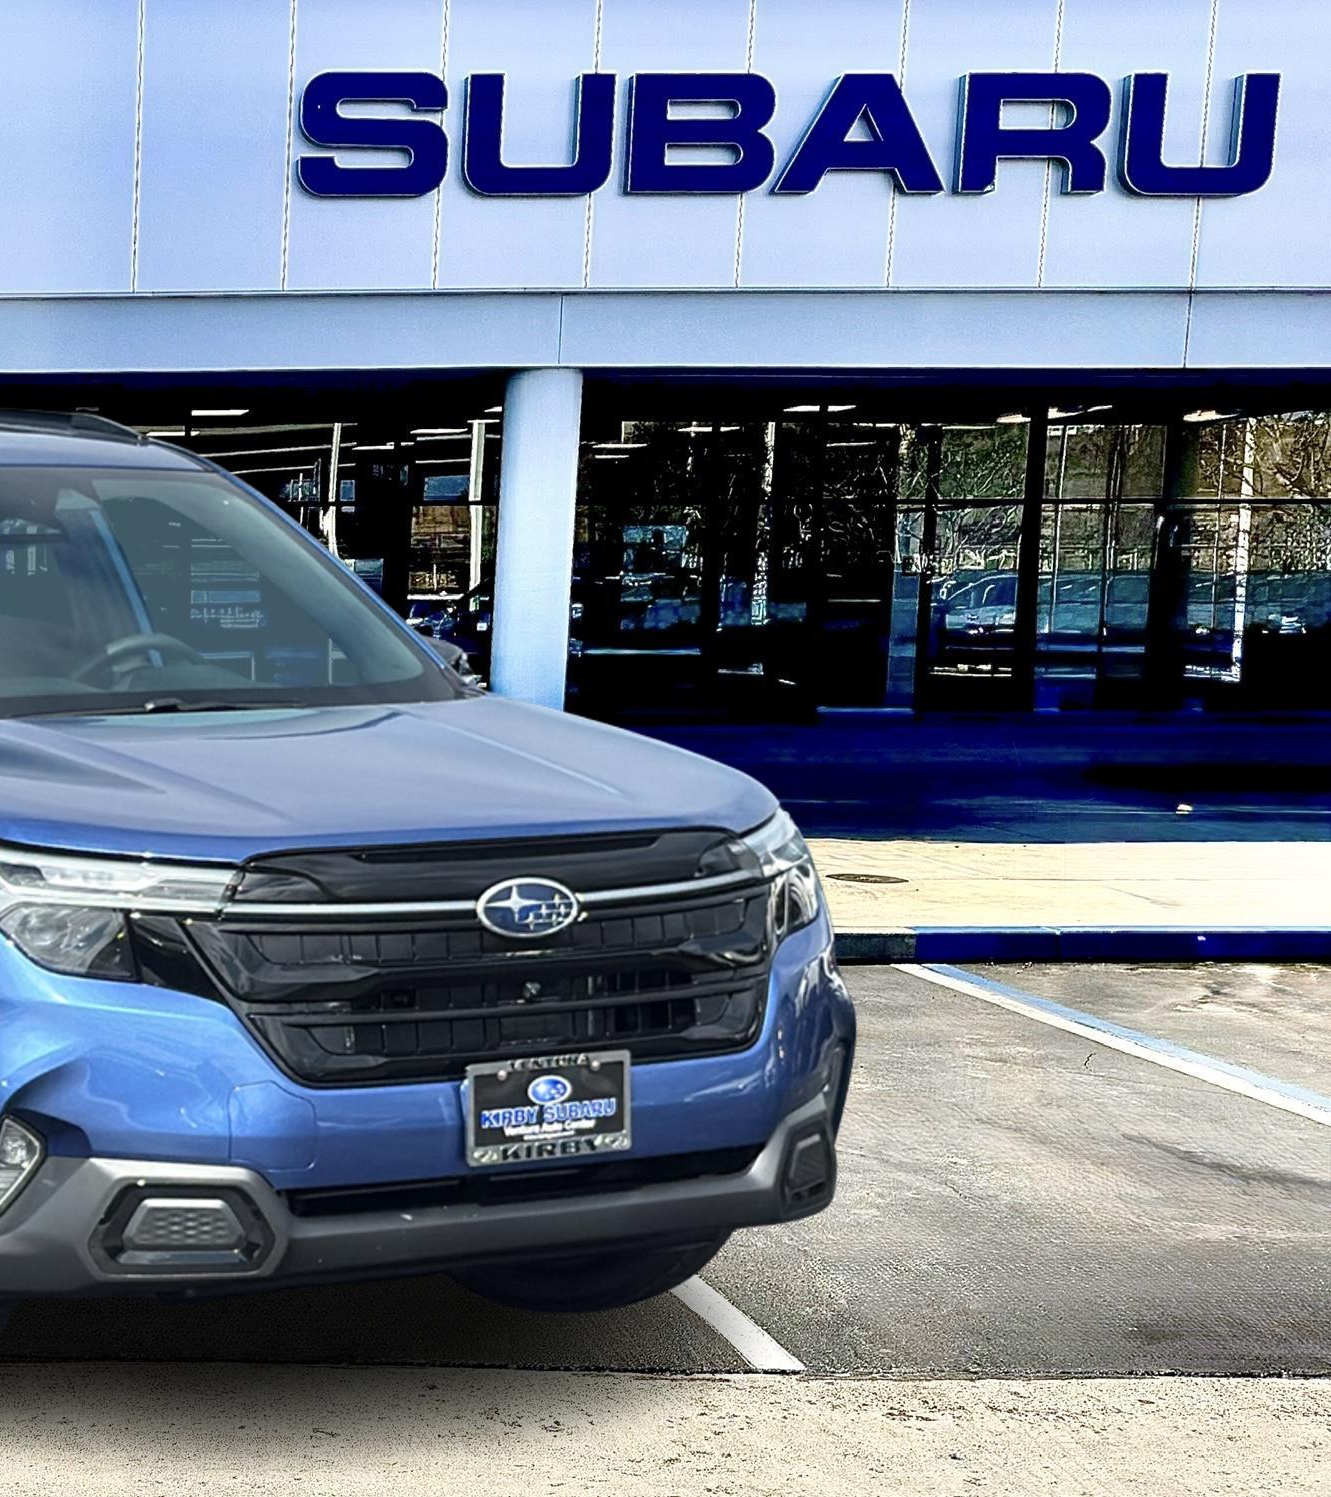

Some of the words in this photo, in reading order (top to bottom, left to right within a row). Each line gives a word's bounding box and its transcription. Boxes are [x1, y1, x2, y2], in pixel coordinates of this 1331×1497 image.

[297, 71, 1283, 197] SUBARU
[481, 1106, 539, 1128] KIRBY
[543, 1098, 616, 1121] SUBARU
[501, 1136, 601, 1160] KIRBY
